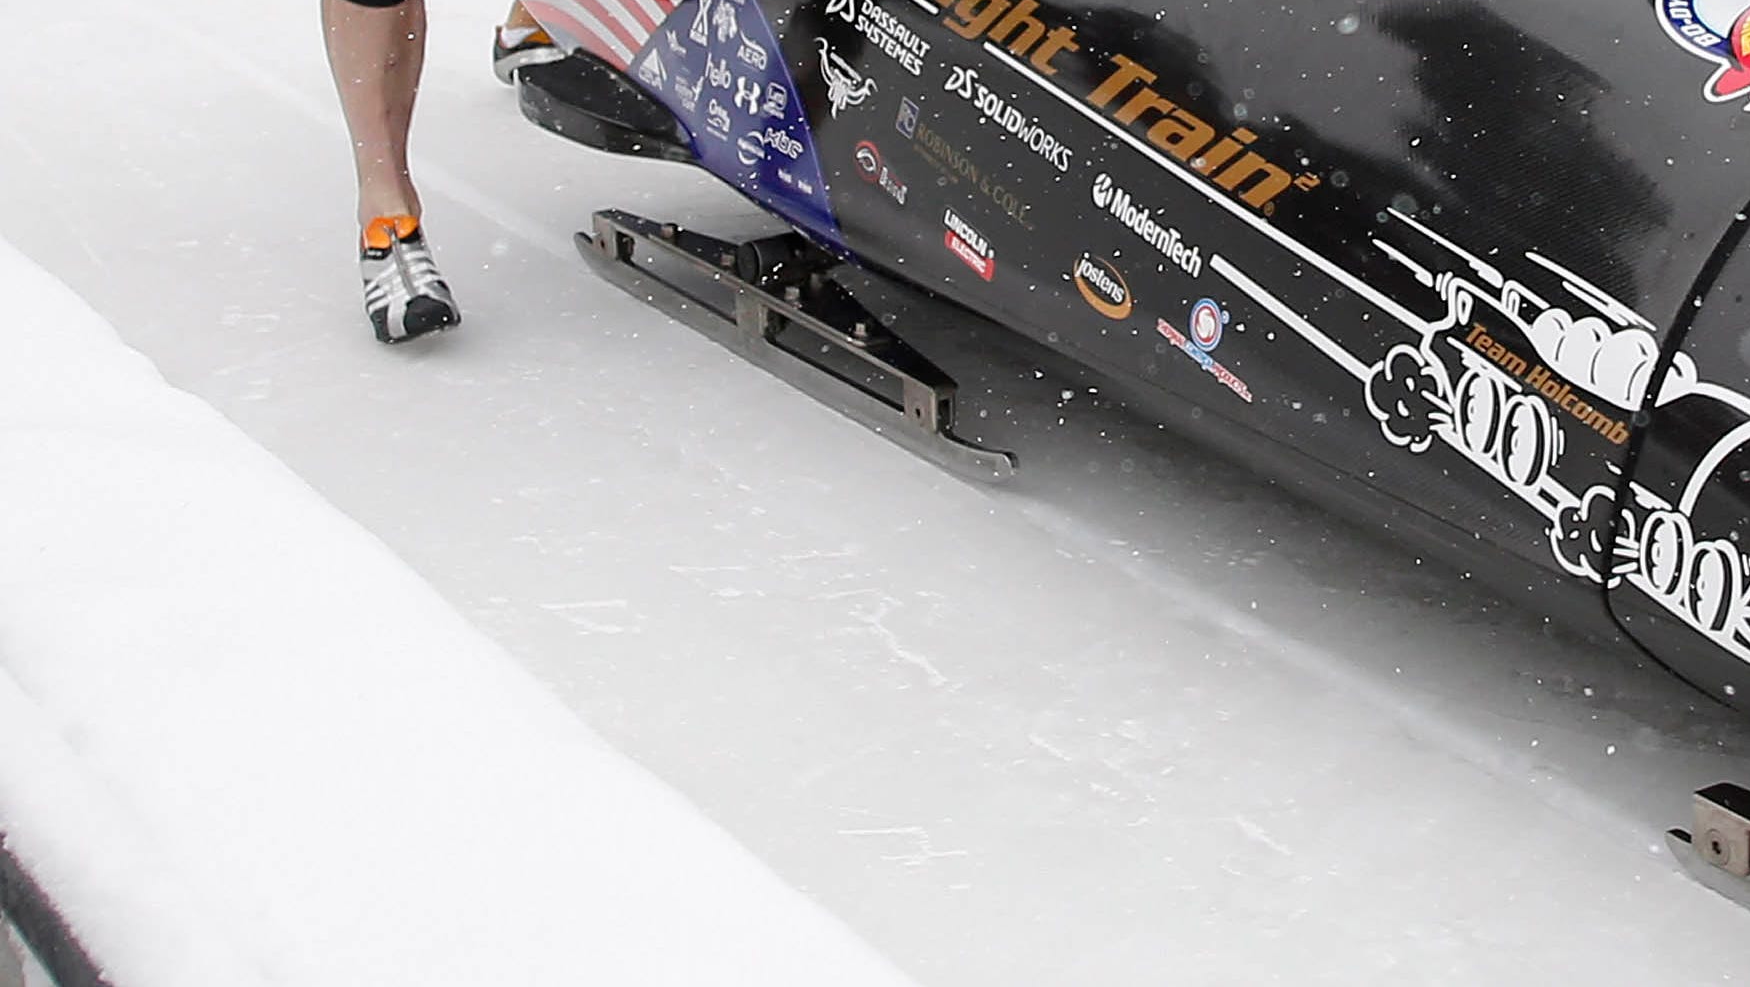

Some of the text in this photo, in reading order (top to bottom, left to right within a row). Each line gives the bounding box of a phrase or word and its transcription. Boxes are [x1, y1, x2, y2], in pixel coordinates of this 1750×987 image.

[914, 123, 979, 184] ROBINSON
[974, 83, 1074, 173] SOLIDWORKS
[943, 209, 989, 257] LINCOLN
[1109, 187, 1202, 279] ModernTech
[1074, 253, 1125, 305] jostens
[1465, 321, 1631, 446] Team Holcomb
